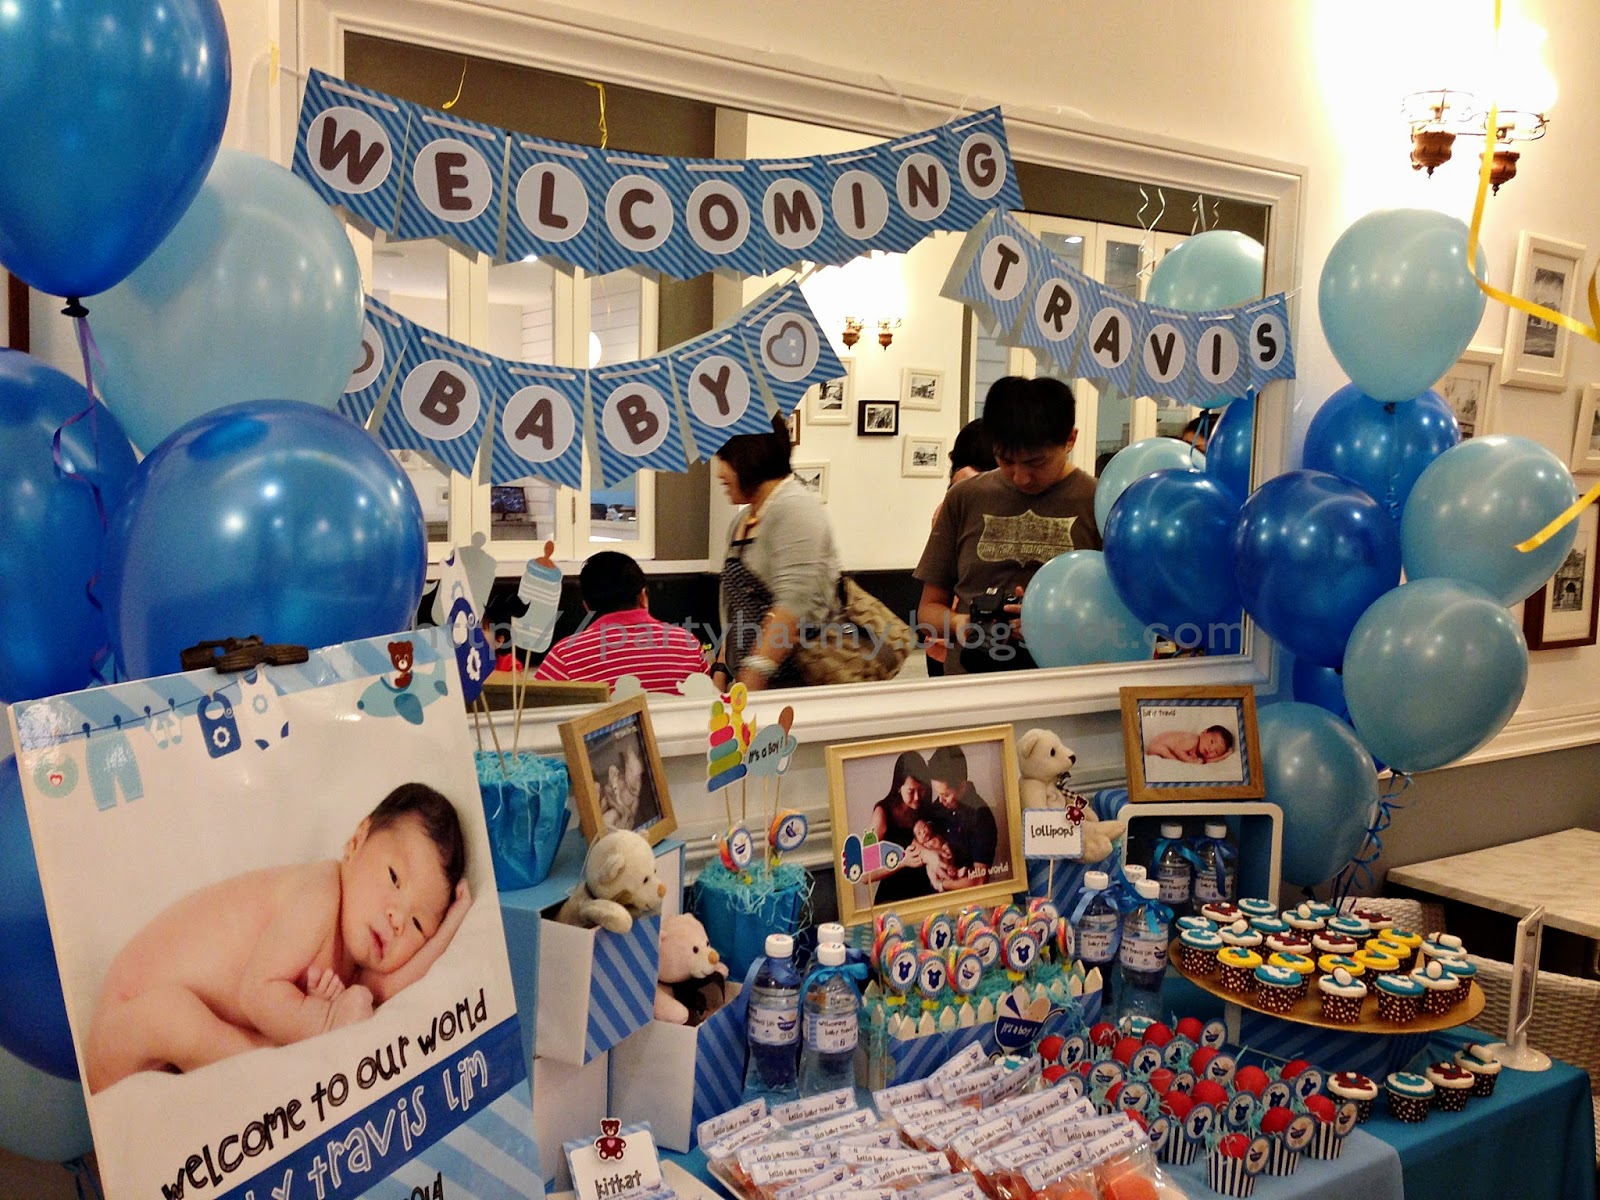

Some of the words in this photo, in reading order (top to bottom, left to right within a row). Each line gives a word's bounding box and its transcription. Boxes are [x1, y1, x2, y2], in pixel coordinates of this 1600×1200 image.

[319, 116, 997, 240] WELCOMING
[995, 242, 1278, 376] TRAVIS
[419, 365, 732, 451] BABY
[968, 868, 987, 880] hello
[988, 861, 1009, 875] world
[161, 1099, 306, 1200] welcome
[311, 1073, 349, 1122] to
[356, 1035, 410, 1090] our
[417, 988, 488, 1056] world
[307, 1084, 427, 1200] travis
[595, 1169, 642, 1199] kitkat
